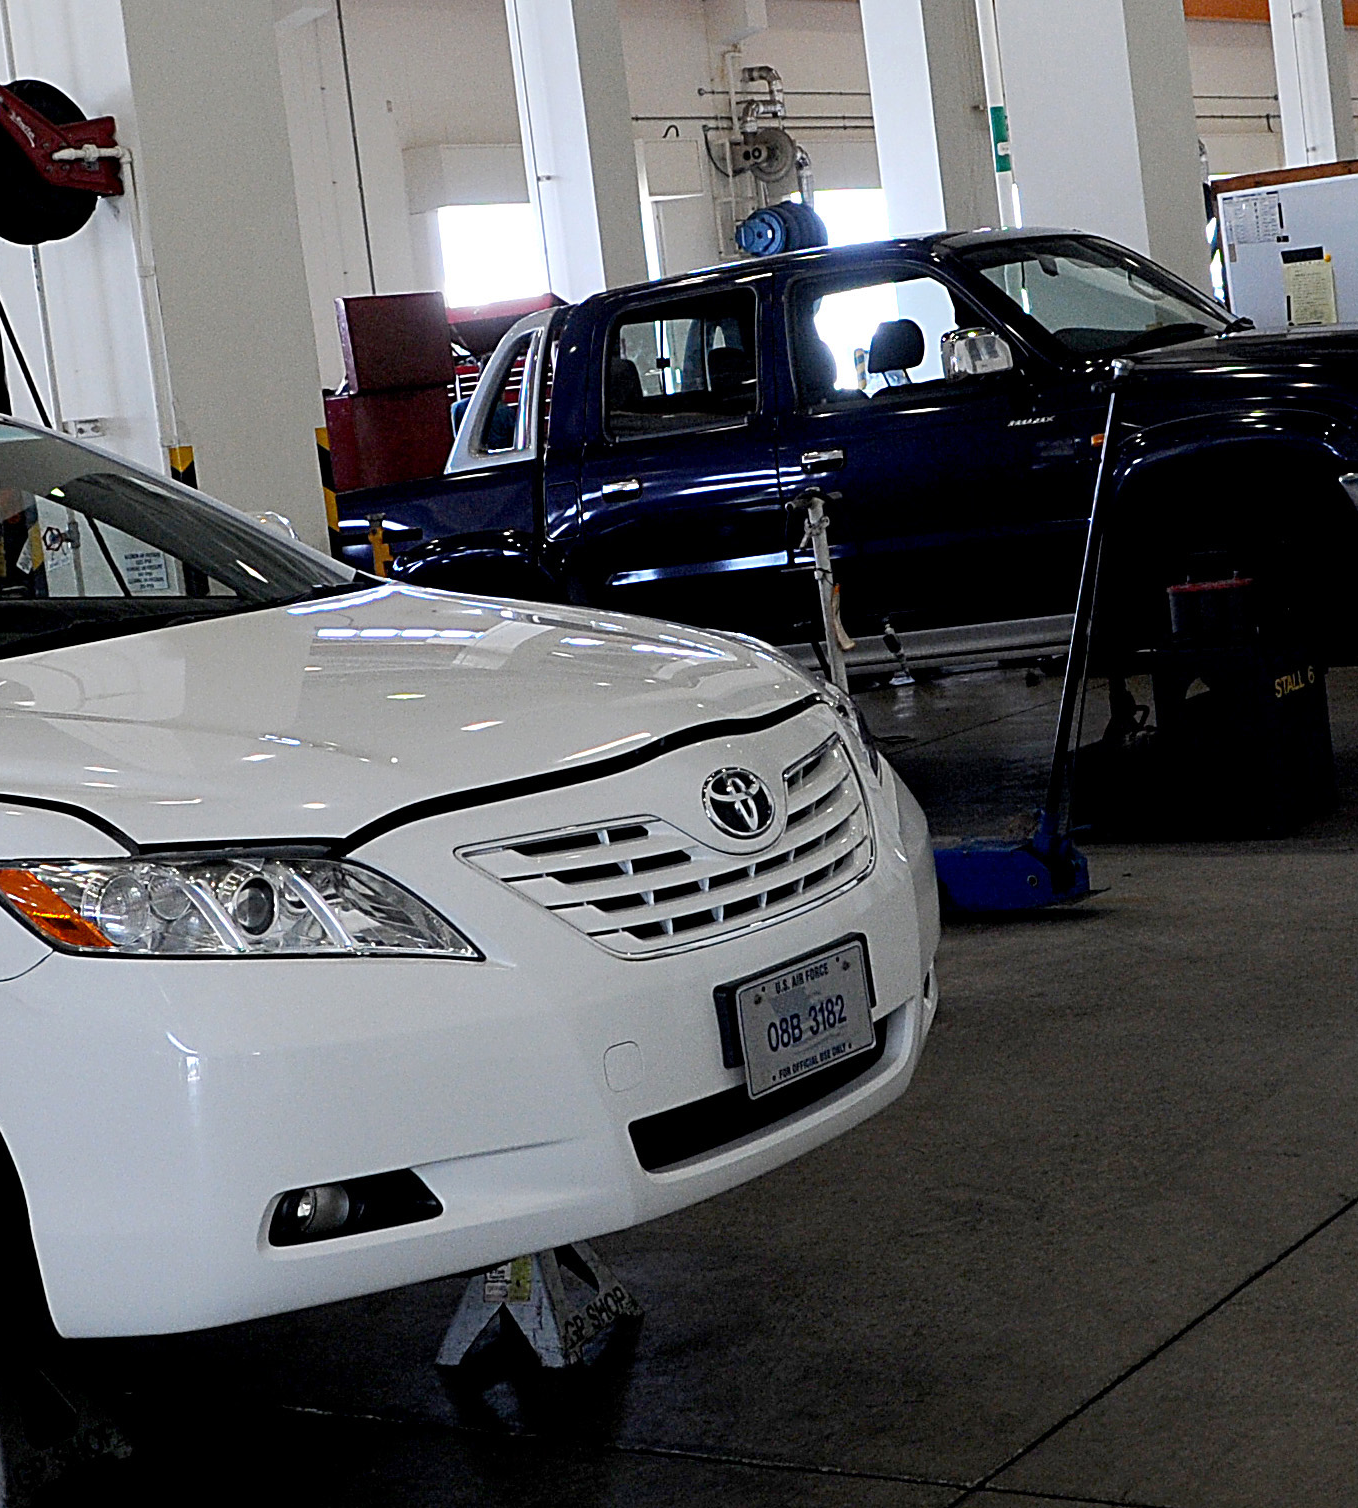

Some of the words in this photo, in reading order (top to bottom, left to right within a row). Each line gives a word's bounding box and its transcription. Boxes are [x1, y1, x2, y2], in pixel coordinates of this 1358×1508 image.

[1275, 670, 1305, 698] STALL
[1307, 665, 1315, 684] 6
[775, 979, 790, 994] U.S.
[792, 972, 804, 988] AIR
[805, 962, 828, 982] FORCE
[768, 1013, 803, 1052] 08B
[808, 994, 847, 1035] 3182
[778, 1065, 791, 1079] FOR
[792, 1055, 818, 1073] OFFICIAL
[820, 1050, 831, 1062] USE
[832, 1042, 846, 1056] ONLY
[585, 1284, 626, 1329] SHOP
